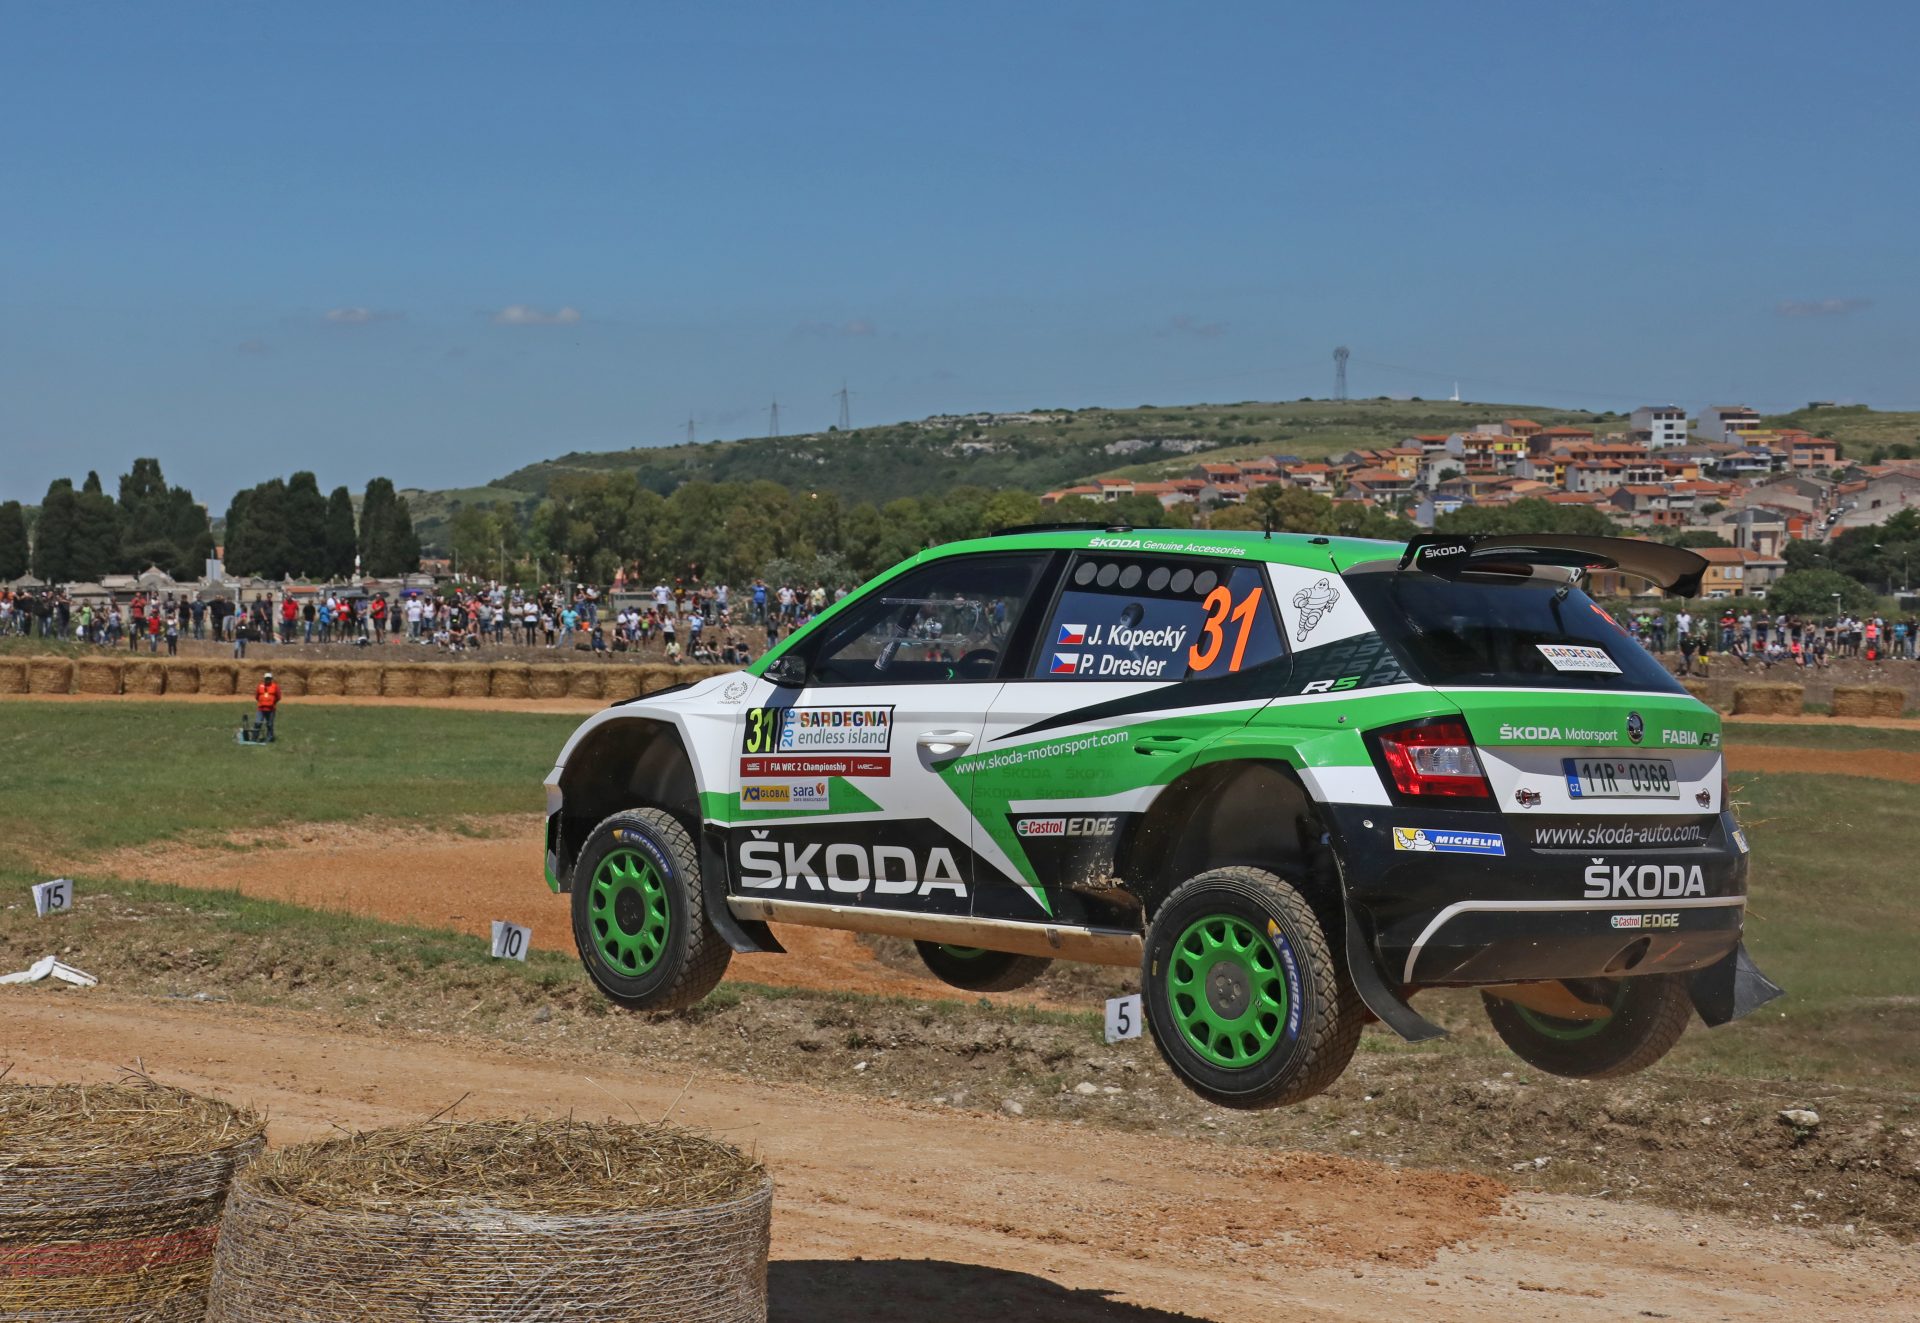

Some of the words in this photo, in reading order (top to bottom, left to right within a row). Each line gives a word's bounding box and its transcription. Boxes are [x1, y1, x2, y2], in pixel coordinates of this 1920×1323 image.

[1088, 538, 1141, 549] ŠKODA
[1143, 541, 1183, 551] Genuine
[1184, 543, 1247, 556] Accessories
[1425, 545, 1466, 558] ŠKODA
[1087, 625, 1102, 645] J.
[1107, 625, 1187, 652] Kopecký
[1188, 585, 1263, 672] 31
[1079, 654, 1095, 674] P.
[1100, 652, 1167, 676] Dresler
[1542, 648, 1608, 660] SARDEGNA
[1300, 676, 1361, 694] R5
[781, 709, 796, 747] 2018
[800, 711, 888, 727] SARDEGNA
[746, 708, 775, 753] 31
[798, 728, 845, 744] endless
[848, 728, 887, 744] island
[1499, 723, 1561, 740] ŠKODA
[1565, 727, 1619, 743] Motorsport
[1662, 729, 1699, 746] FABIA
[954, 731, 1129, 775] www.skoda-motorsport.com
[770, 763, 780, 771] FIA
[782, 763, 795, 771] WRC
[797, 763, 801, 771] 2
[803, 762, 847, 772] Championship
[1570, 783, 1580, 792] CZ
[1583, 763, 1619, 792] 11R
[1629, 763, 1670, 792] 0368
[761, 789, 790, 798] GLOBAL
[793, 786, 814, 797] sara
[1029, 820, 1063, 835] Castrol
[1066, 817, 1118, 836] EDGE
[1535, 823, 1701, 844] www.skoda-auto.com
[1435, 835, 1501, 847] MICHELIN
[630, 832, 669, 874] MICHELIN
[740, 830, 968, 898] ŠKODA
[1584, 858, 1706, 898] ŠKODA
[46, 884, 64, 912] 15
[1618, 915, 1640, 927] Castrol
[1642, 913, 1680, 928] EDGE
[502, 926, 522, 957] 10
[1281, 949, 1299, 1033] MICHELIN
[1117, 1001, 1130, 1035] 5
